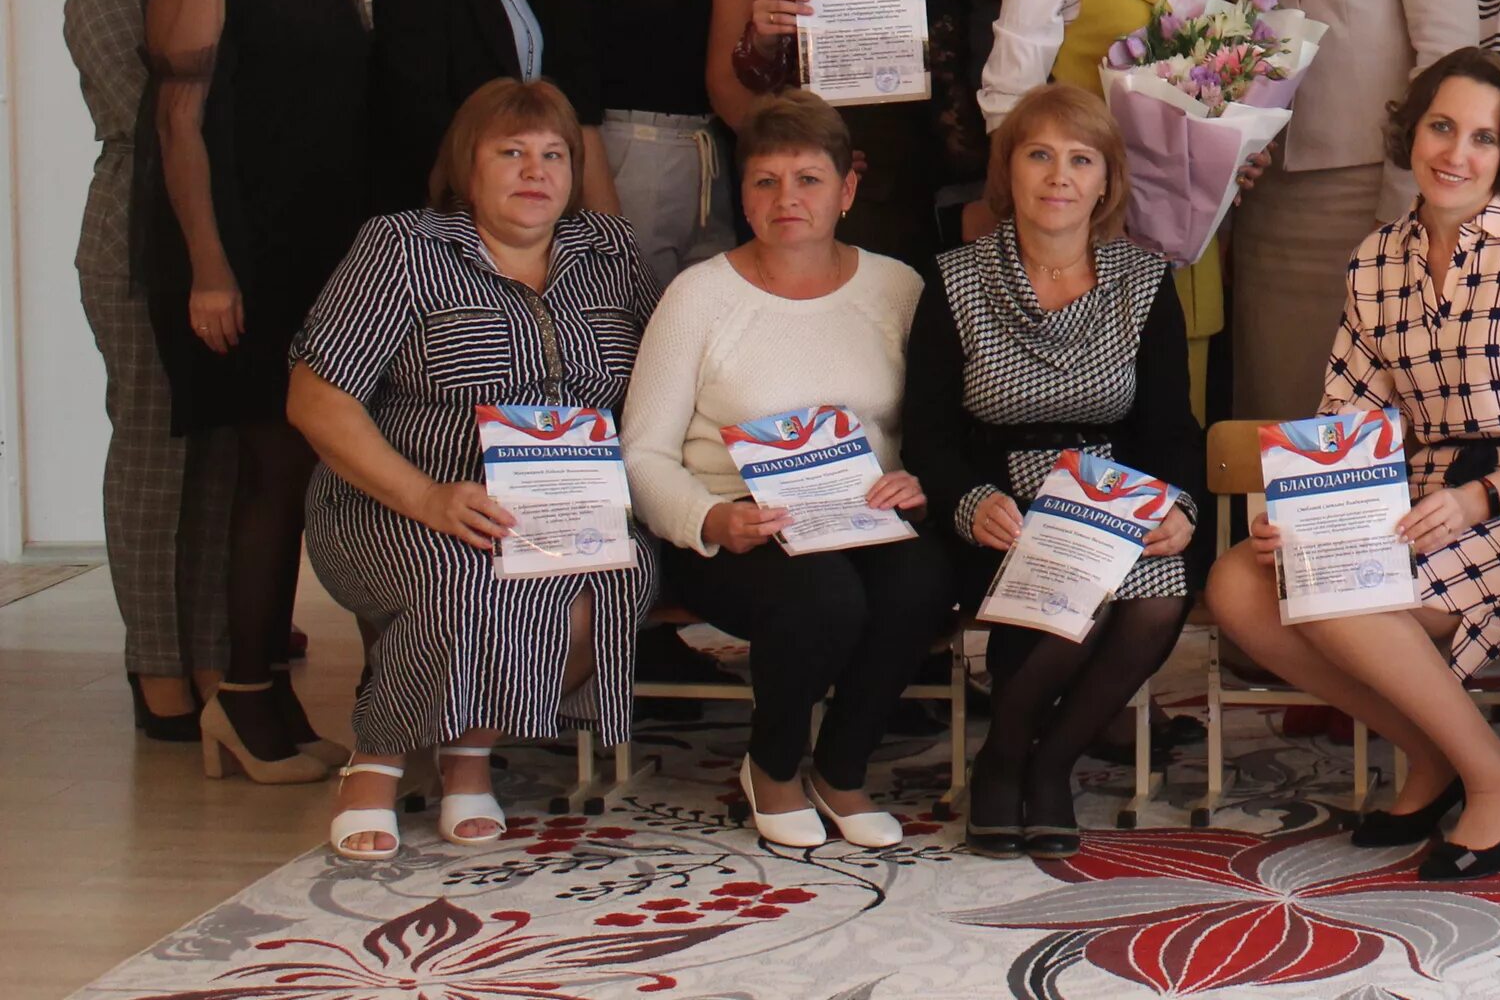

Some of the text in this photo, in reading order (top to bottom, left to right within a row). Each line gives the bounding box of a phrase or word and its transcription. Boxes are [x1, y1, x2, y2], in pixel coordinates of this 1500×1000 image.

[498, 446, 613, 458] БЛАГОДАРНОСТЬ
[752, 441, 862, 474] БЛАГОДАРНОСТЬ
[1279, 466, 1398, 493] БЛАГОДАРНОСТЬ
[1043, 498, 1143, 539] БЛАГОДАРНОСТЬ
